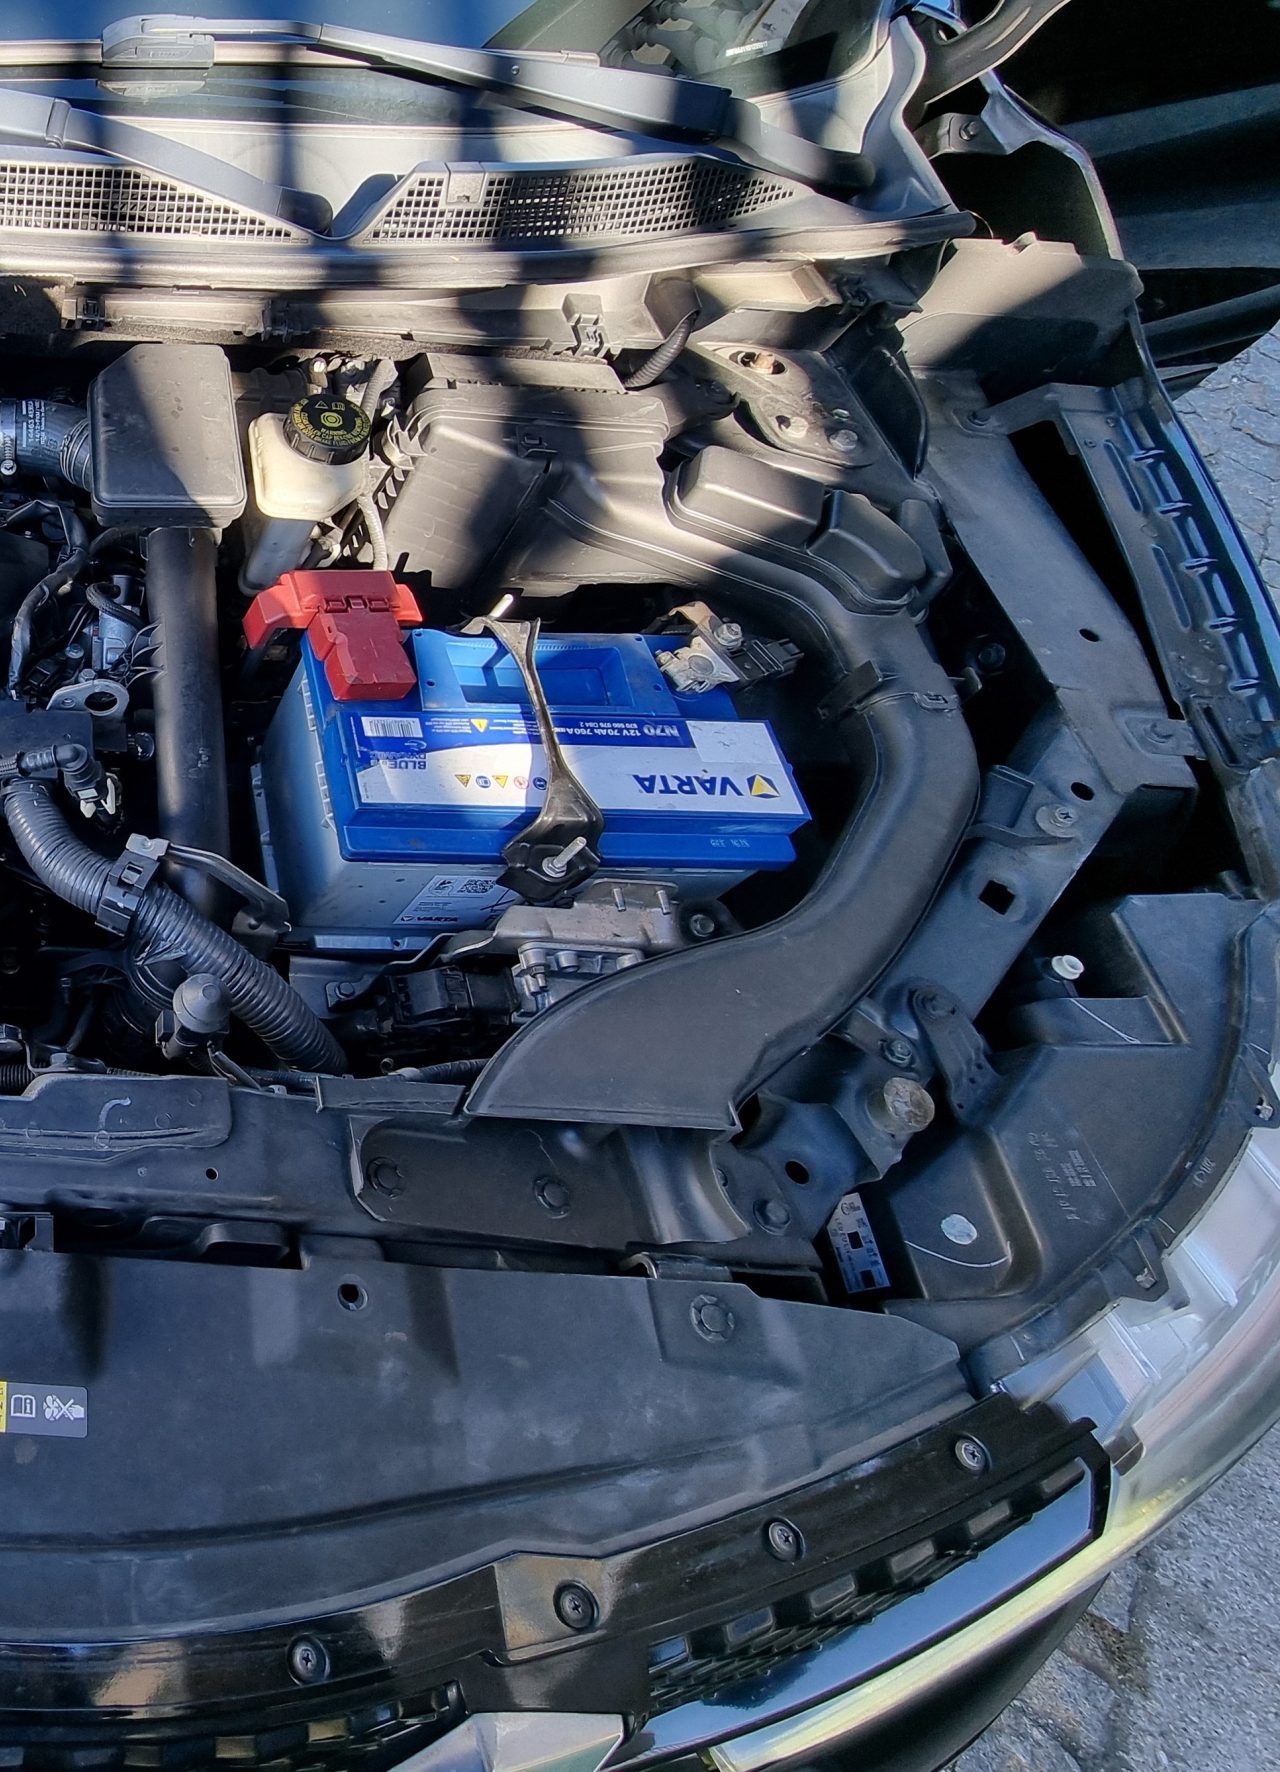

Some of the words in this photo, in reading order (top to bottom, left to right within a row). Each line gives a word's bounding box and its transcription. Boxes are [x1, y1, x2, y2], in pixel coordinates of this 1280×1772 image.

[622, 728, 641, 736] 12V
[643, 724, 680, 737] N70
[388, 760, 426, 770] BLUE
[632, 774, 744, 796] VARTA
